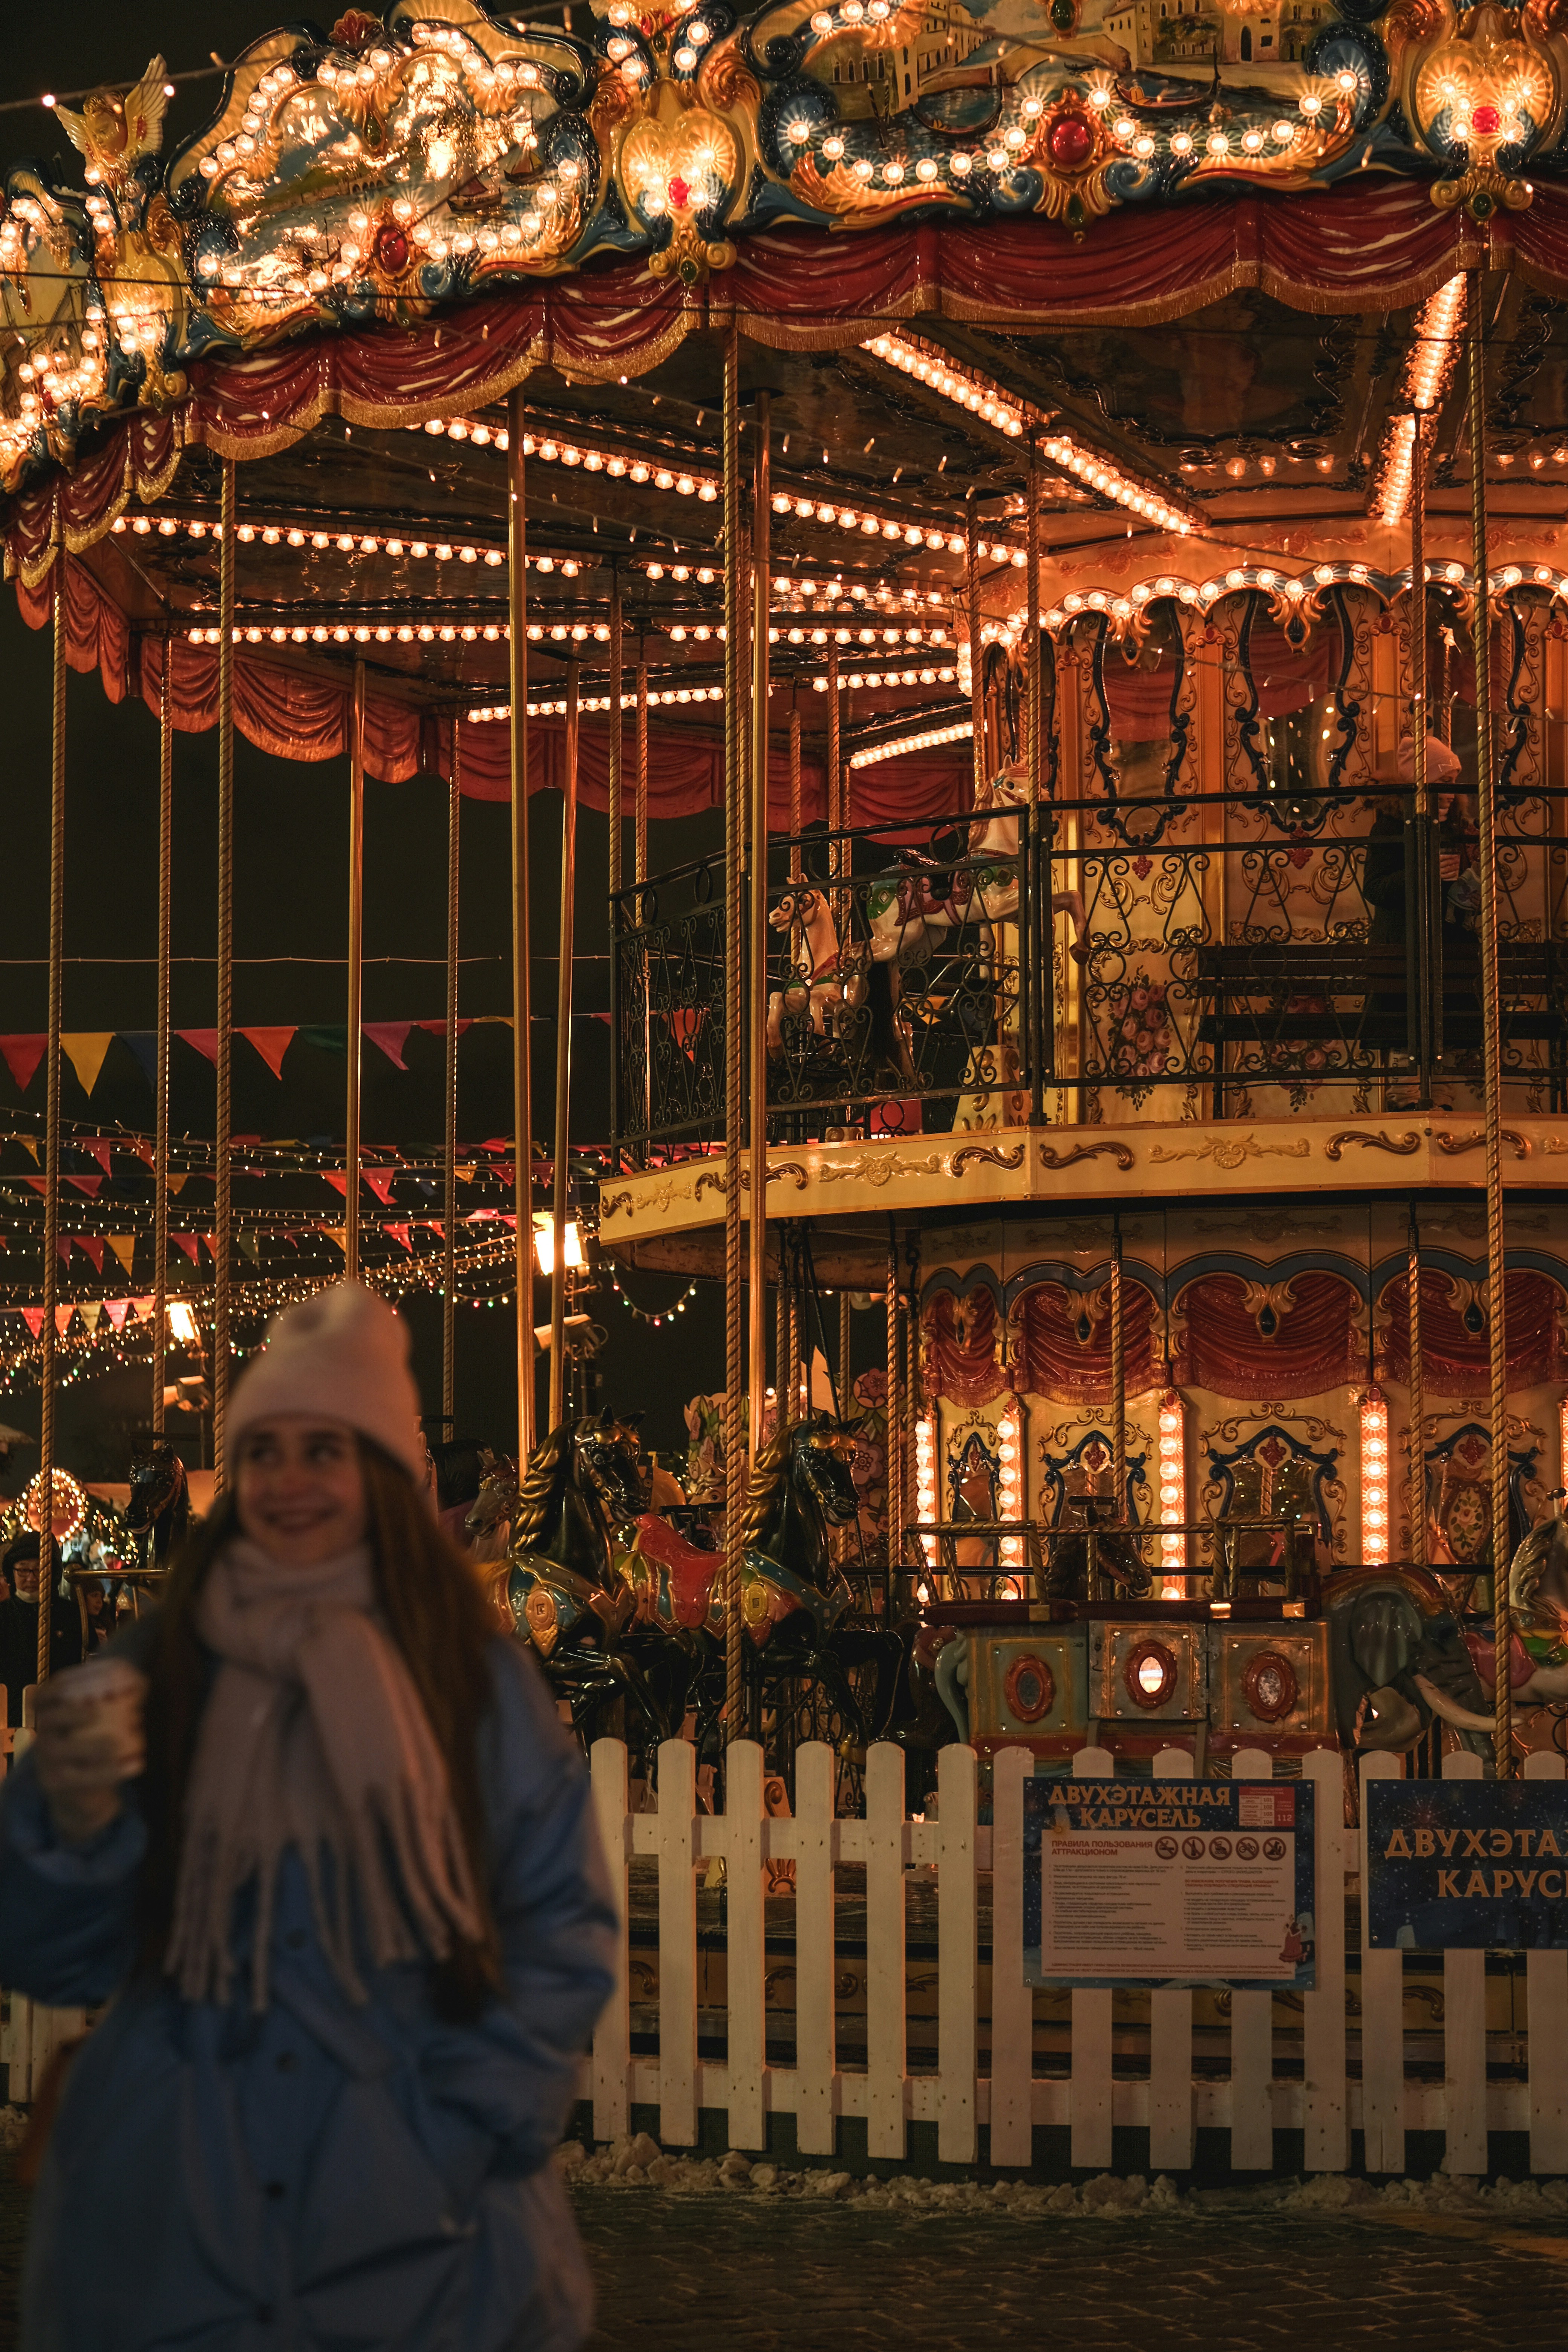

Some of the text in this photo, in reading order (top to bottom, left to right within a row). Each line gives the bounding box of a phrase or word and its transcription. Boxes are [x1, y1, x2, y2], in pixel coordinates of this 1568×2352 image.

[1048, 1785, 1230, 1806] ДВУХЭТАЖНАЯ
[1080, 1808, 1201, 1827] КАРУСЕЛЬ
[1384, 1829, 1568, 1860] ДВУХЭТА
[1437, 1870, 1568, 1898] КАРУС
